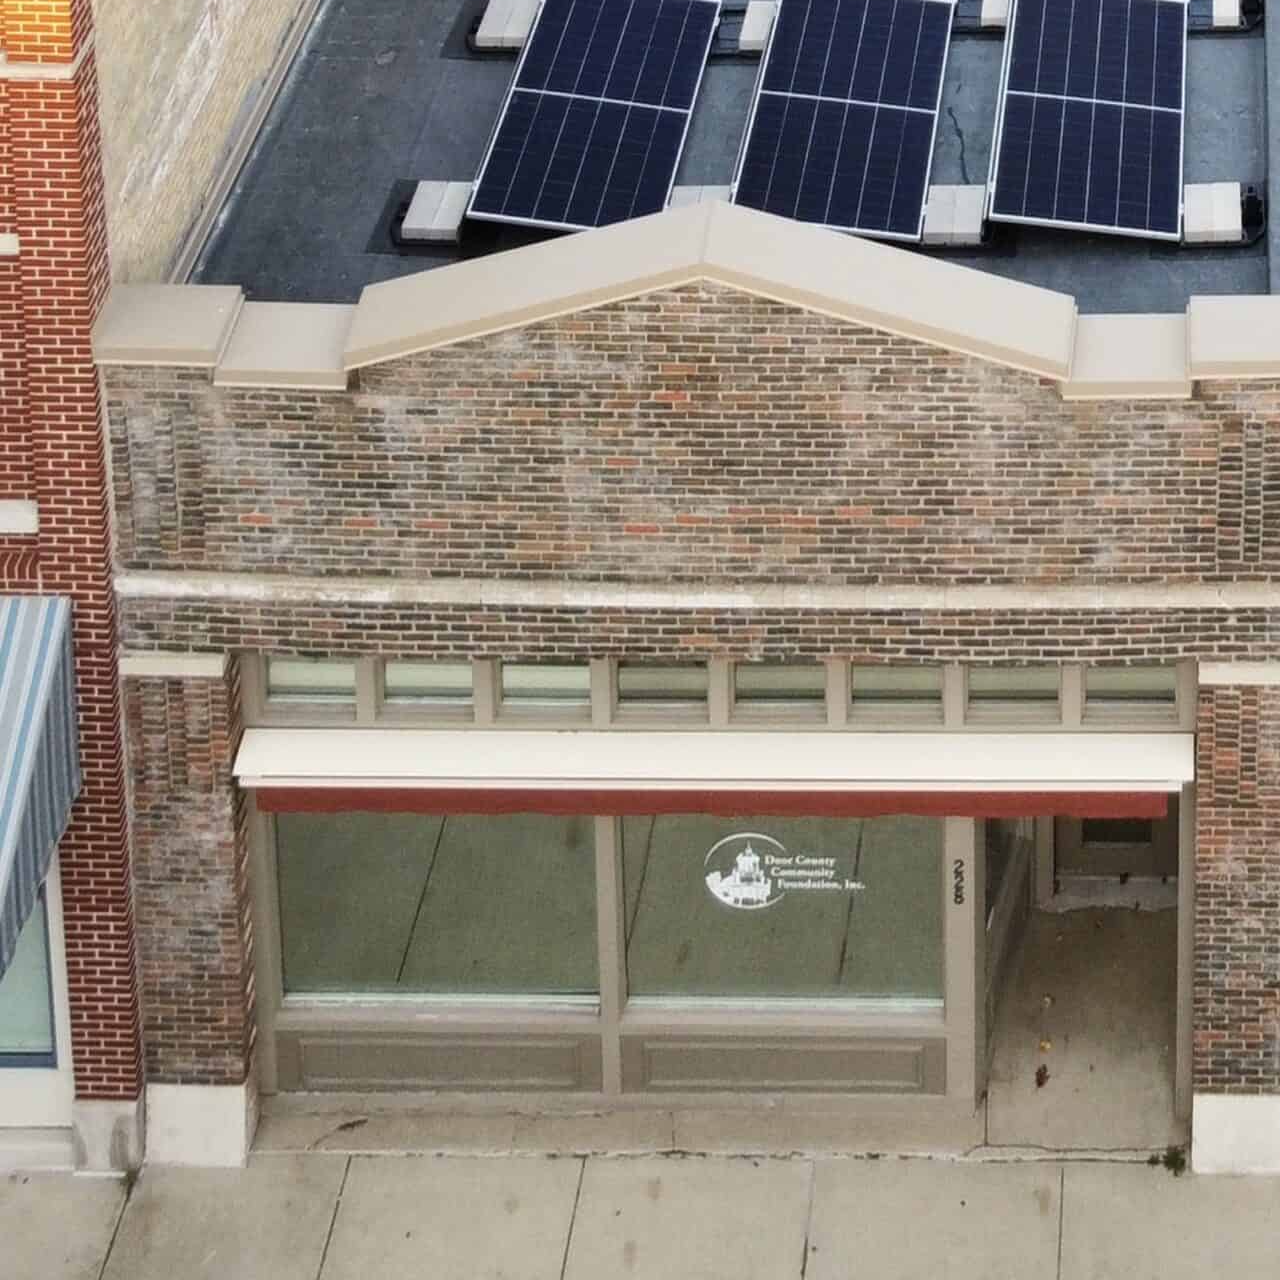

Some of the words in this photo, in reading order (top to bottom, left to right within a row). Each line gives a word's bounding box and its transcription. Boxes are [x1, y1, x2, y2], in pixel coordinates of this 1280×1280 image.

[796, 854, 836, 868] County
[771, 866, 834, 879] Community
[778, 880, 842, 891] Foundation,
[845, 880, 866, 890] Inc.
[953, 859, 965, 906] 228
